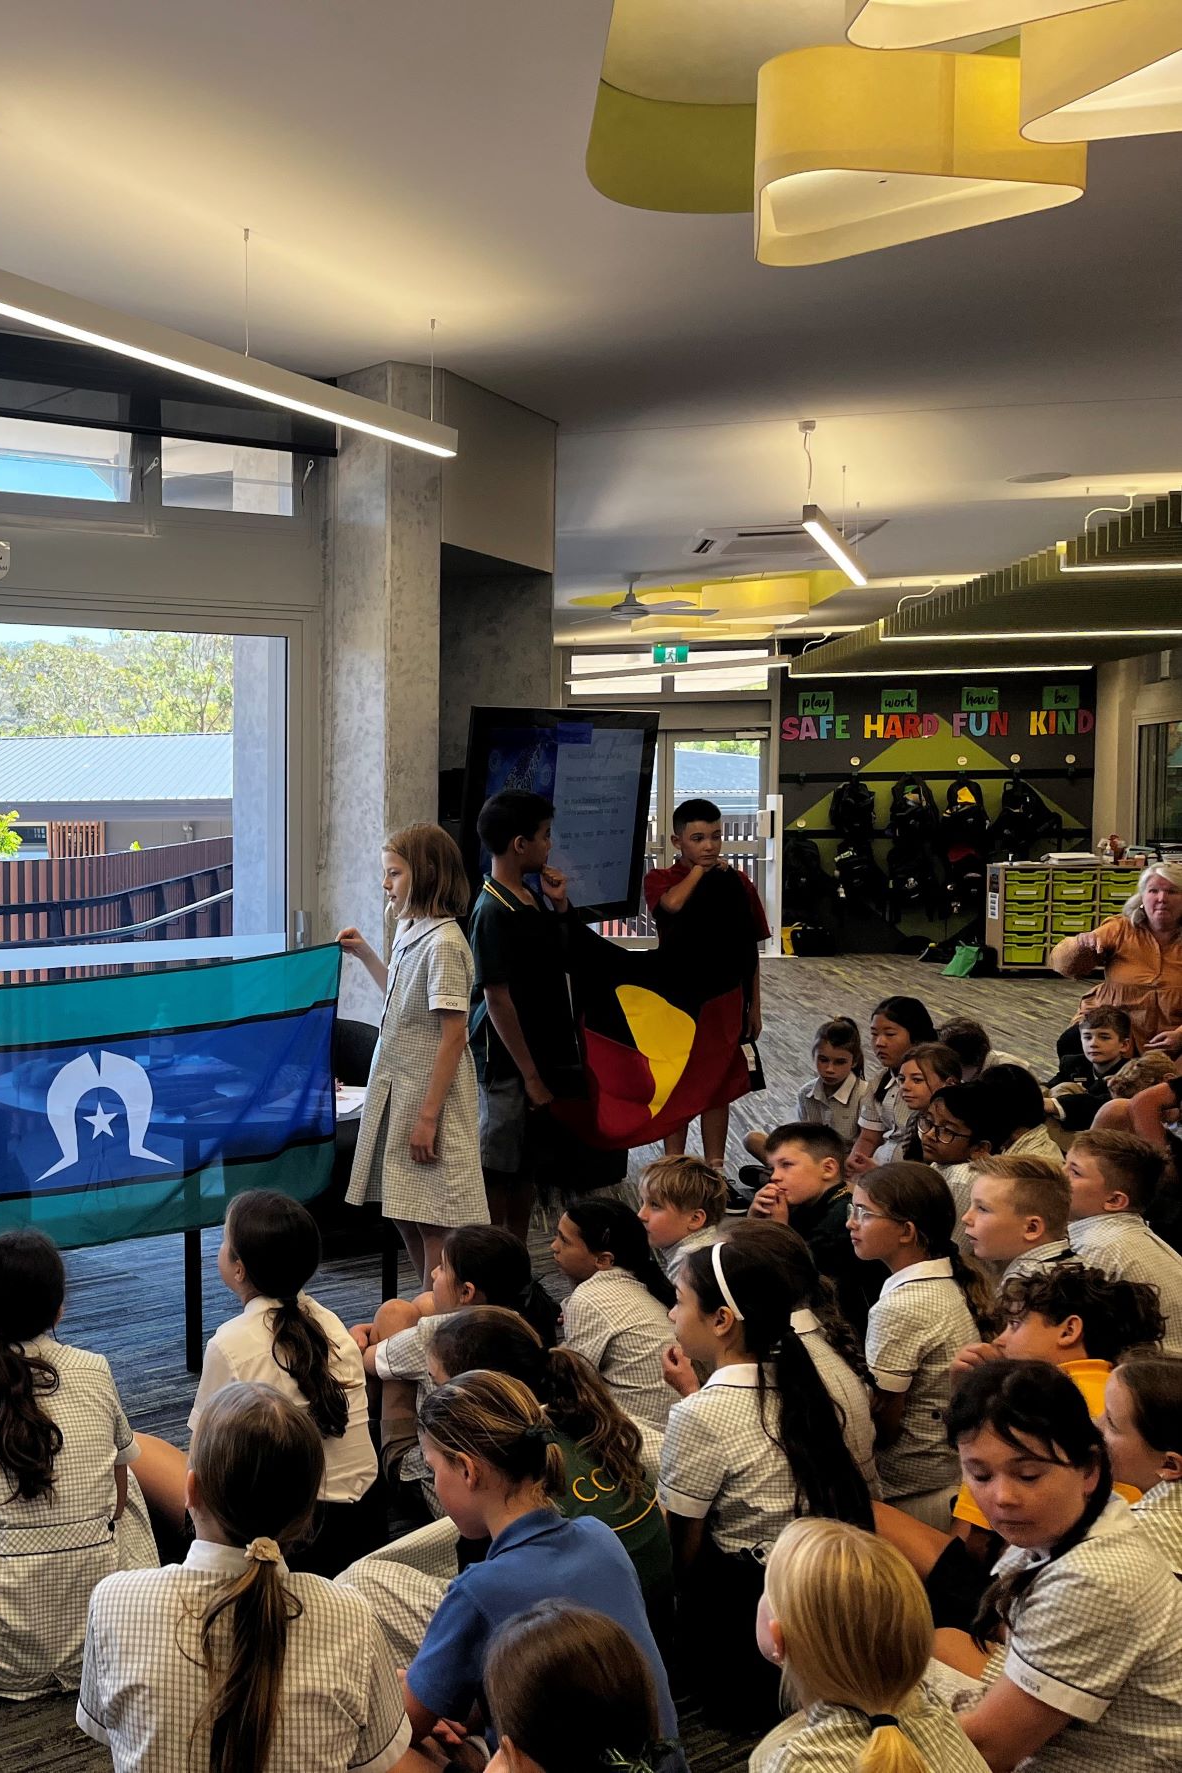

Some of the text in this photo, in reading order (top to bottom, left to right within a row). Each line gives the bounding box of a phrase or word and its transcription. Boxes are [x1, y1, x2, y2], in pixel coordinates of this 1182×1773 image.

[802, 693, 831, 713] play
[884, 693, 915, 708] work
[965, 691, 995, 706] have
[1053, 688, 1070, 704] be
[781, 709, 1095, 741] SAFE HARD FUN KIND
